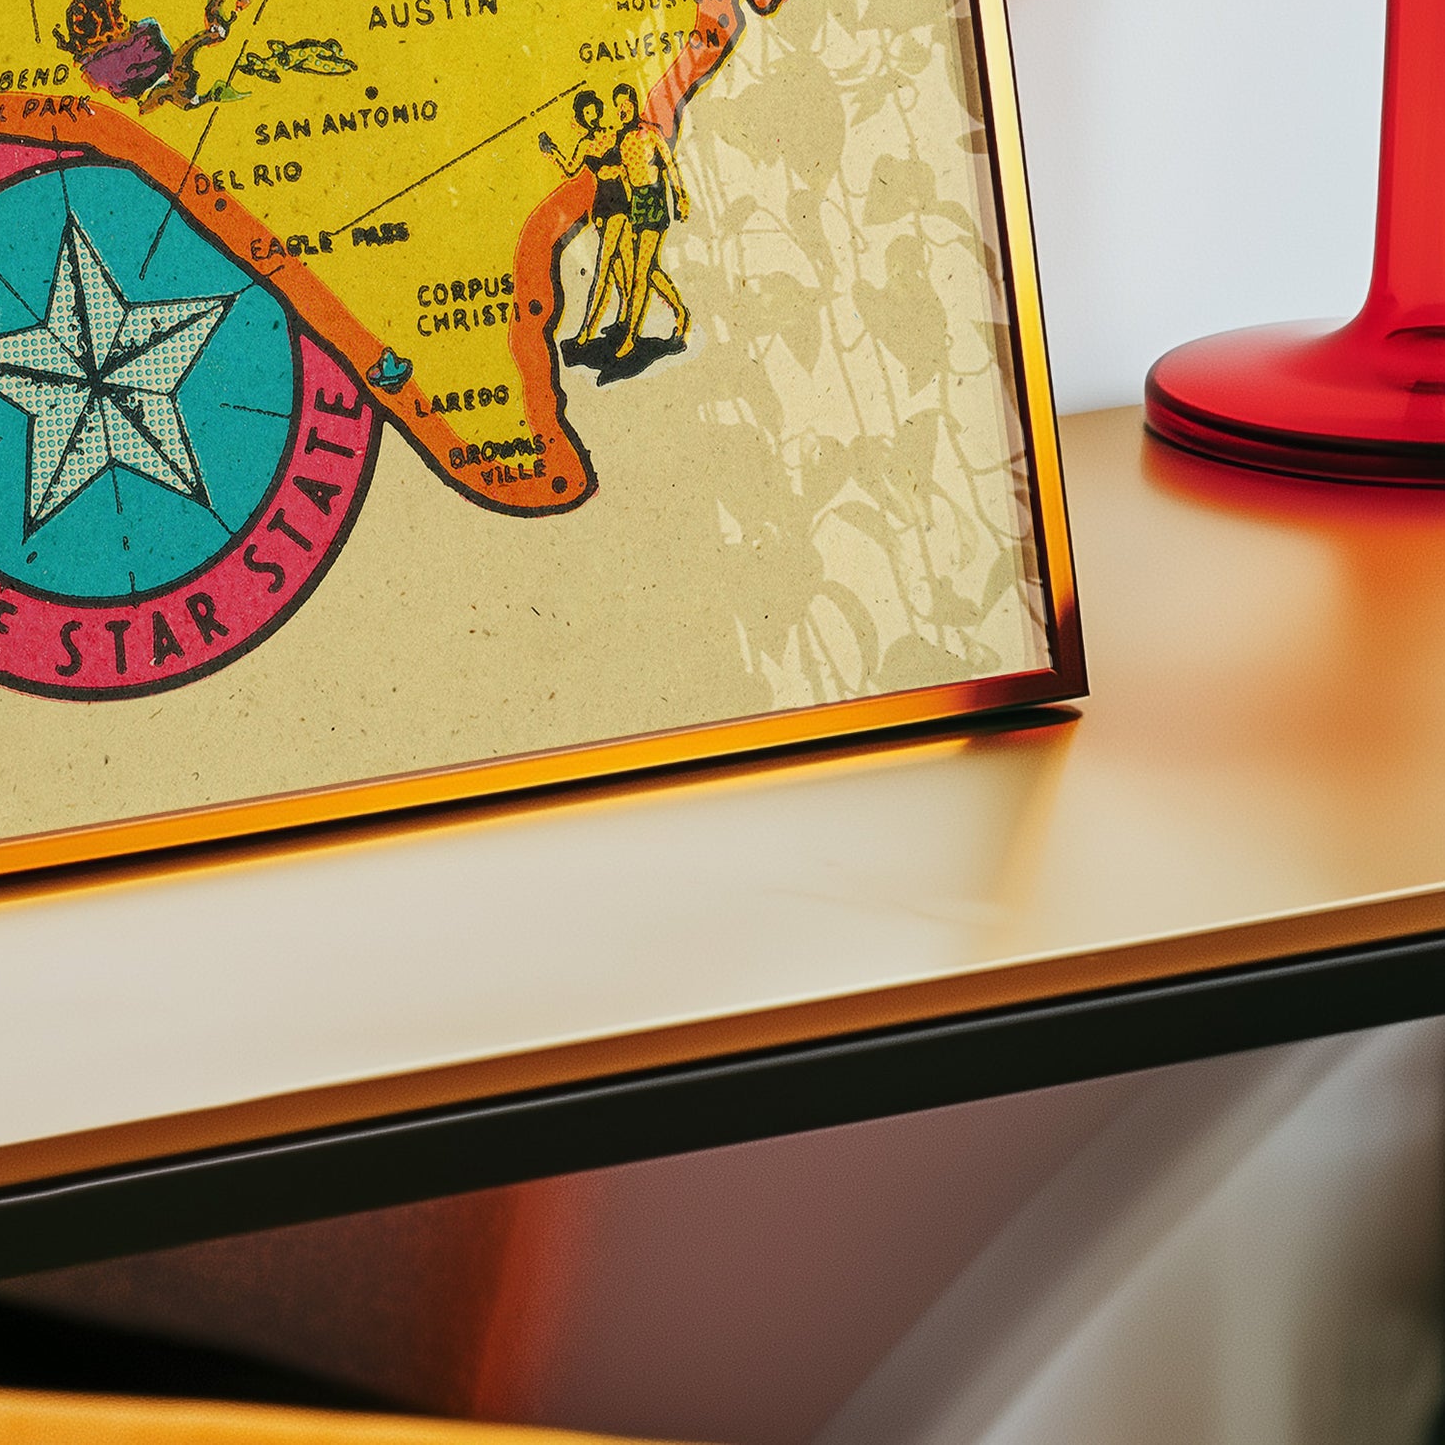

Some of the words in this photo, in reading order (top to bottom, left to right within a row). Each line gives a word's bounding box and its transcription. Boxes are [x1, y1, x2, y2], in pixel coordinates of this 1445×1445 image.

[579, 28, 720, 63] GALVESTON
[22, 95, 91, 122] PARK
[255, 118, 311, 145] SAN
[322, 100, 438, 135] ANTONIO
[194, 169, 244, 196] DEL
[253, 161, 303, 187] RIO
[250, 230, 333, 261] EAGLE
[417, 273, 515, 307] CORPUS
[417, 302, 520, 336] CHRISTI
[414, 385, 509, 417] LAREDO
[481, 459, 546, 486] VILLE
[55, 592, 230, 676] STAR
[243, 385, 371, 593] STATE
